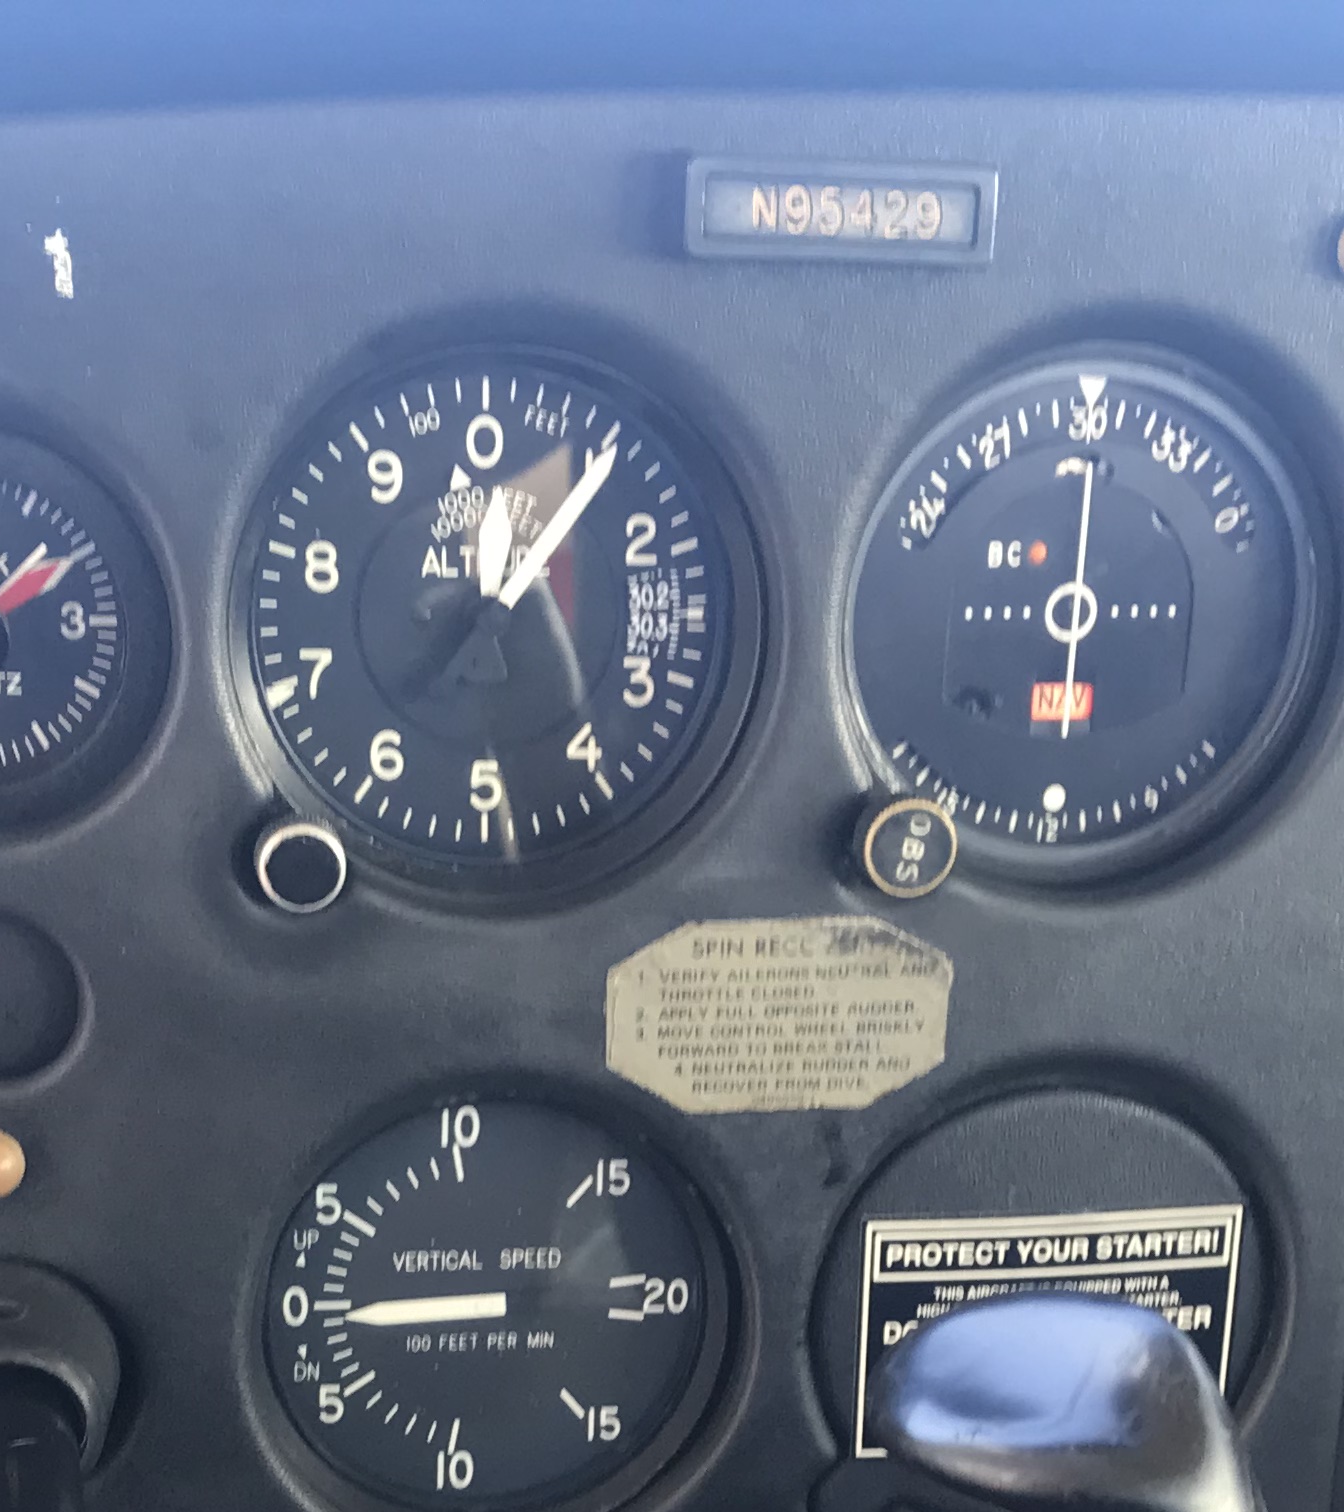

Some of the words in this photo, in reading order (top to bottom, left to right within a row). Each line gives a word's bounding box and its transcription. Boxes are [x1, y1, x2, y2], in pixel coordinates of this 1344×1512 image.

[751, 184, 943, 240] N95429
[409, 407, 440, 438] 100
[525, 404, 569, 438] FEET
[466, 414, 504, 470] 0
[1068, 404, 1106, 441] 30
[367, 450, 403, 504] 9
[625, 512, 657, 566] 2
[305, 540, 339, 593] 8
[60, 601, 86, 641] 3
[299, 647, 333, 700] 7
[623, 655, 654, 708] 3
[370, 729, 404, 781] 6
[567, 722, 602, 771] 4
[470, 759, 502, 812] 5
[895, 813, 931, 882] OBS
[692, 938, 744, 960] SPIN
[440, 1104, 480, 1148] 10
[595, 1158, 631, 1196] 15
[315, 1183, 343, 1225] 5
[293, 1229, 320, 1250] UP
[393, 1249, 482, 1272] VERTICAL
[499, 1246, 562, 1269] SPEED
[886, 1240, 1010, 1269] PROTECT
[1017, 1236, 1090, 1264] YOUR
[1096, 1229, 1219, 1262] STARTER!
[282, 1285, 309, 1327] 0
[642, 1277, 689, 1314] 20
[934, 1284, 964, 1302] THIS
[1125, 1275, 1156, 1293] WITH
[1158, 1274, 1169, 1289] A
[406, 1334, 431, 1353] 100
[439, 1333, 479, 1353] FEET
[487, 1331, 518, 1352] PER
[527, 1330, 555, 1349] MIN
[293, 1360, 320, 1382] DN
[319, 1383, 344, 1424] 5
[587, 1405, 622, 1442] 15
[436, 1449, 474, 1491] 10
